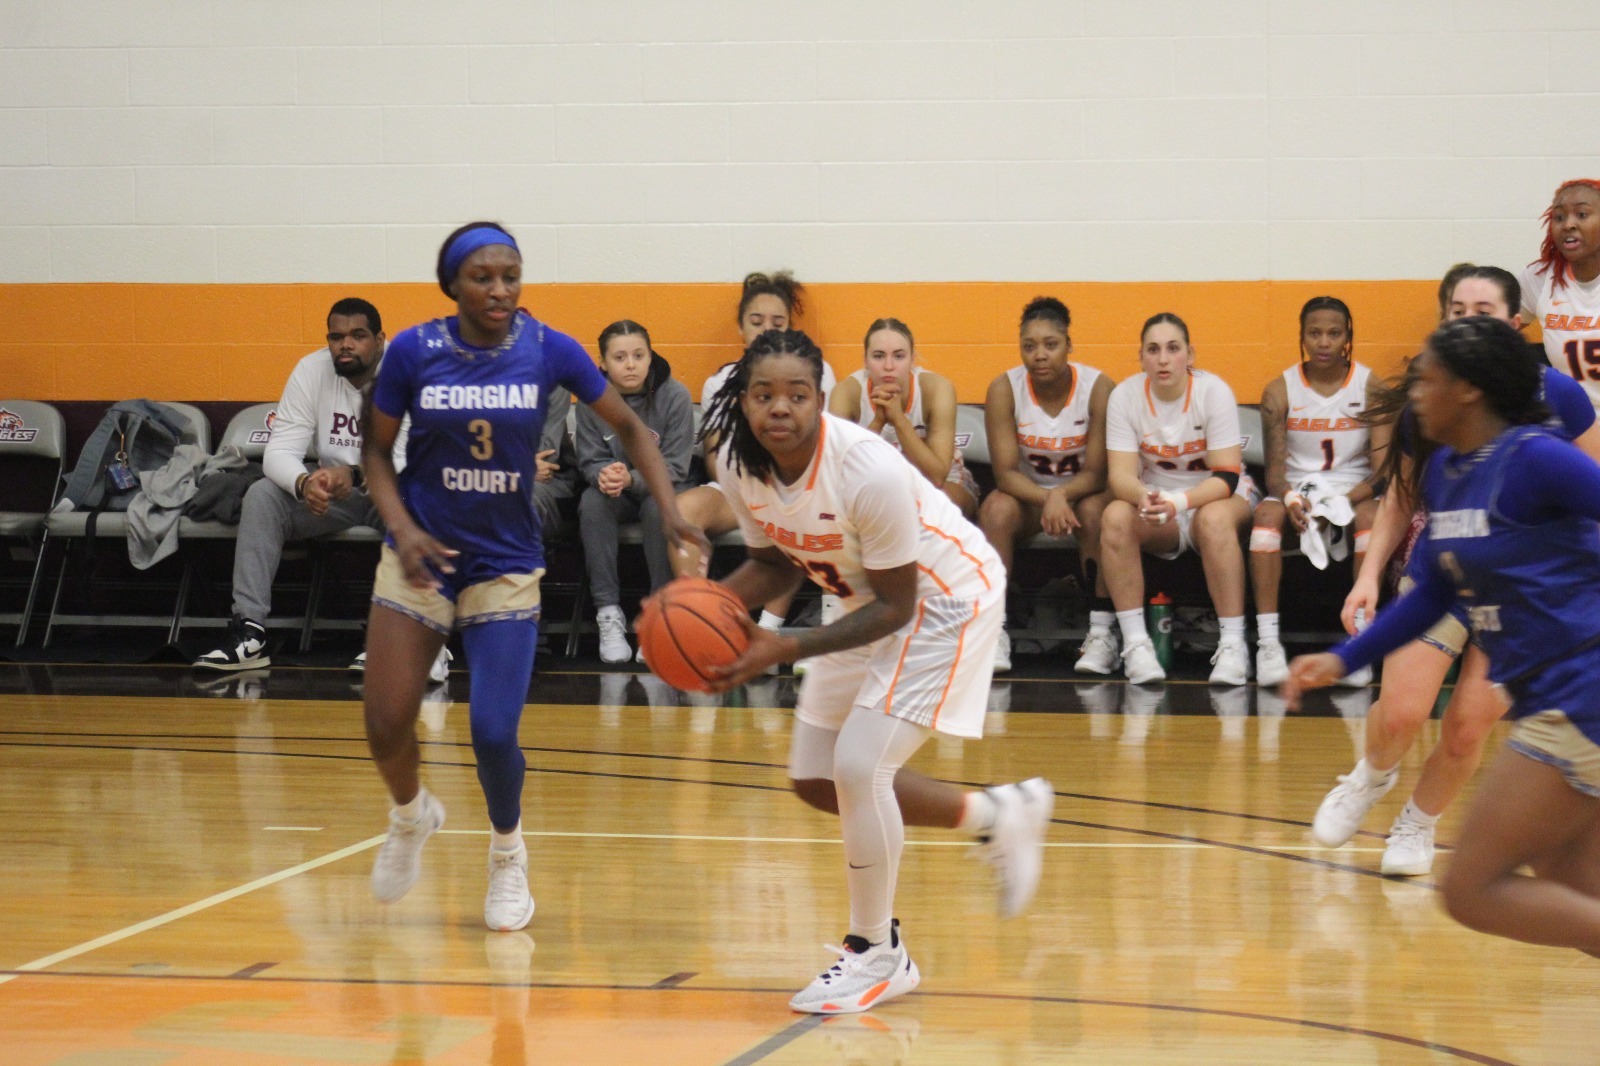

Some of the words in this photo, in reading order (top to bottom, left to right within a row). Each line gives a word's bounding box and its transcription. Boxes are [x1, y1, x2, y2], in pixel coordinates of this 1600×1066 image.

[420, 384, 539, 410] GEORGIAN
[467, 419, 494, 461] 3
[1320, 438, 1335, 472] 1
[442, 467, 520, 494] COURT
